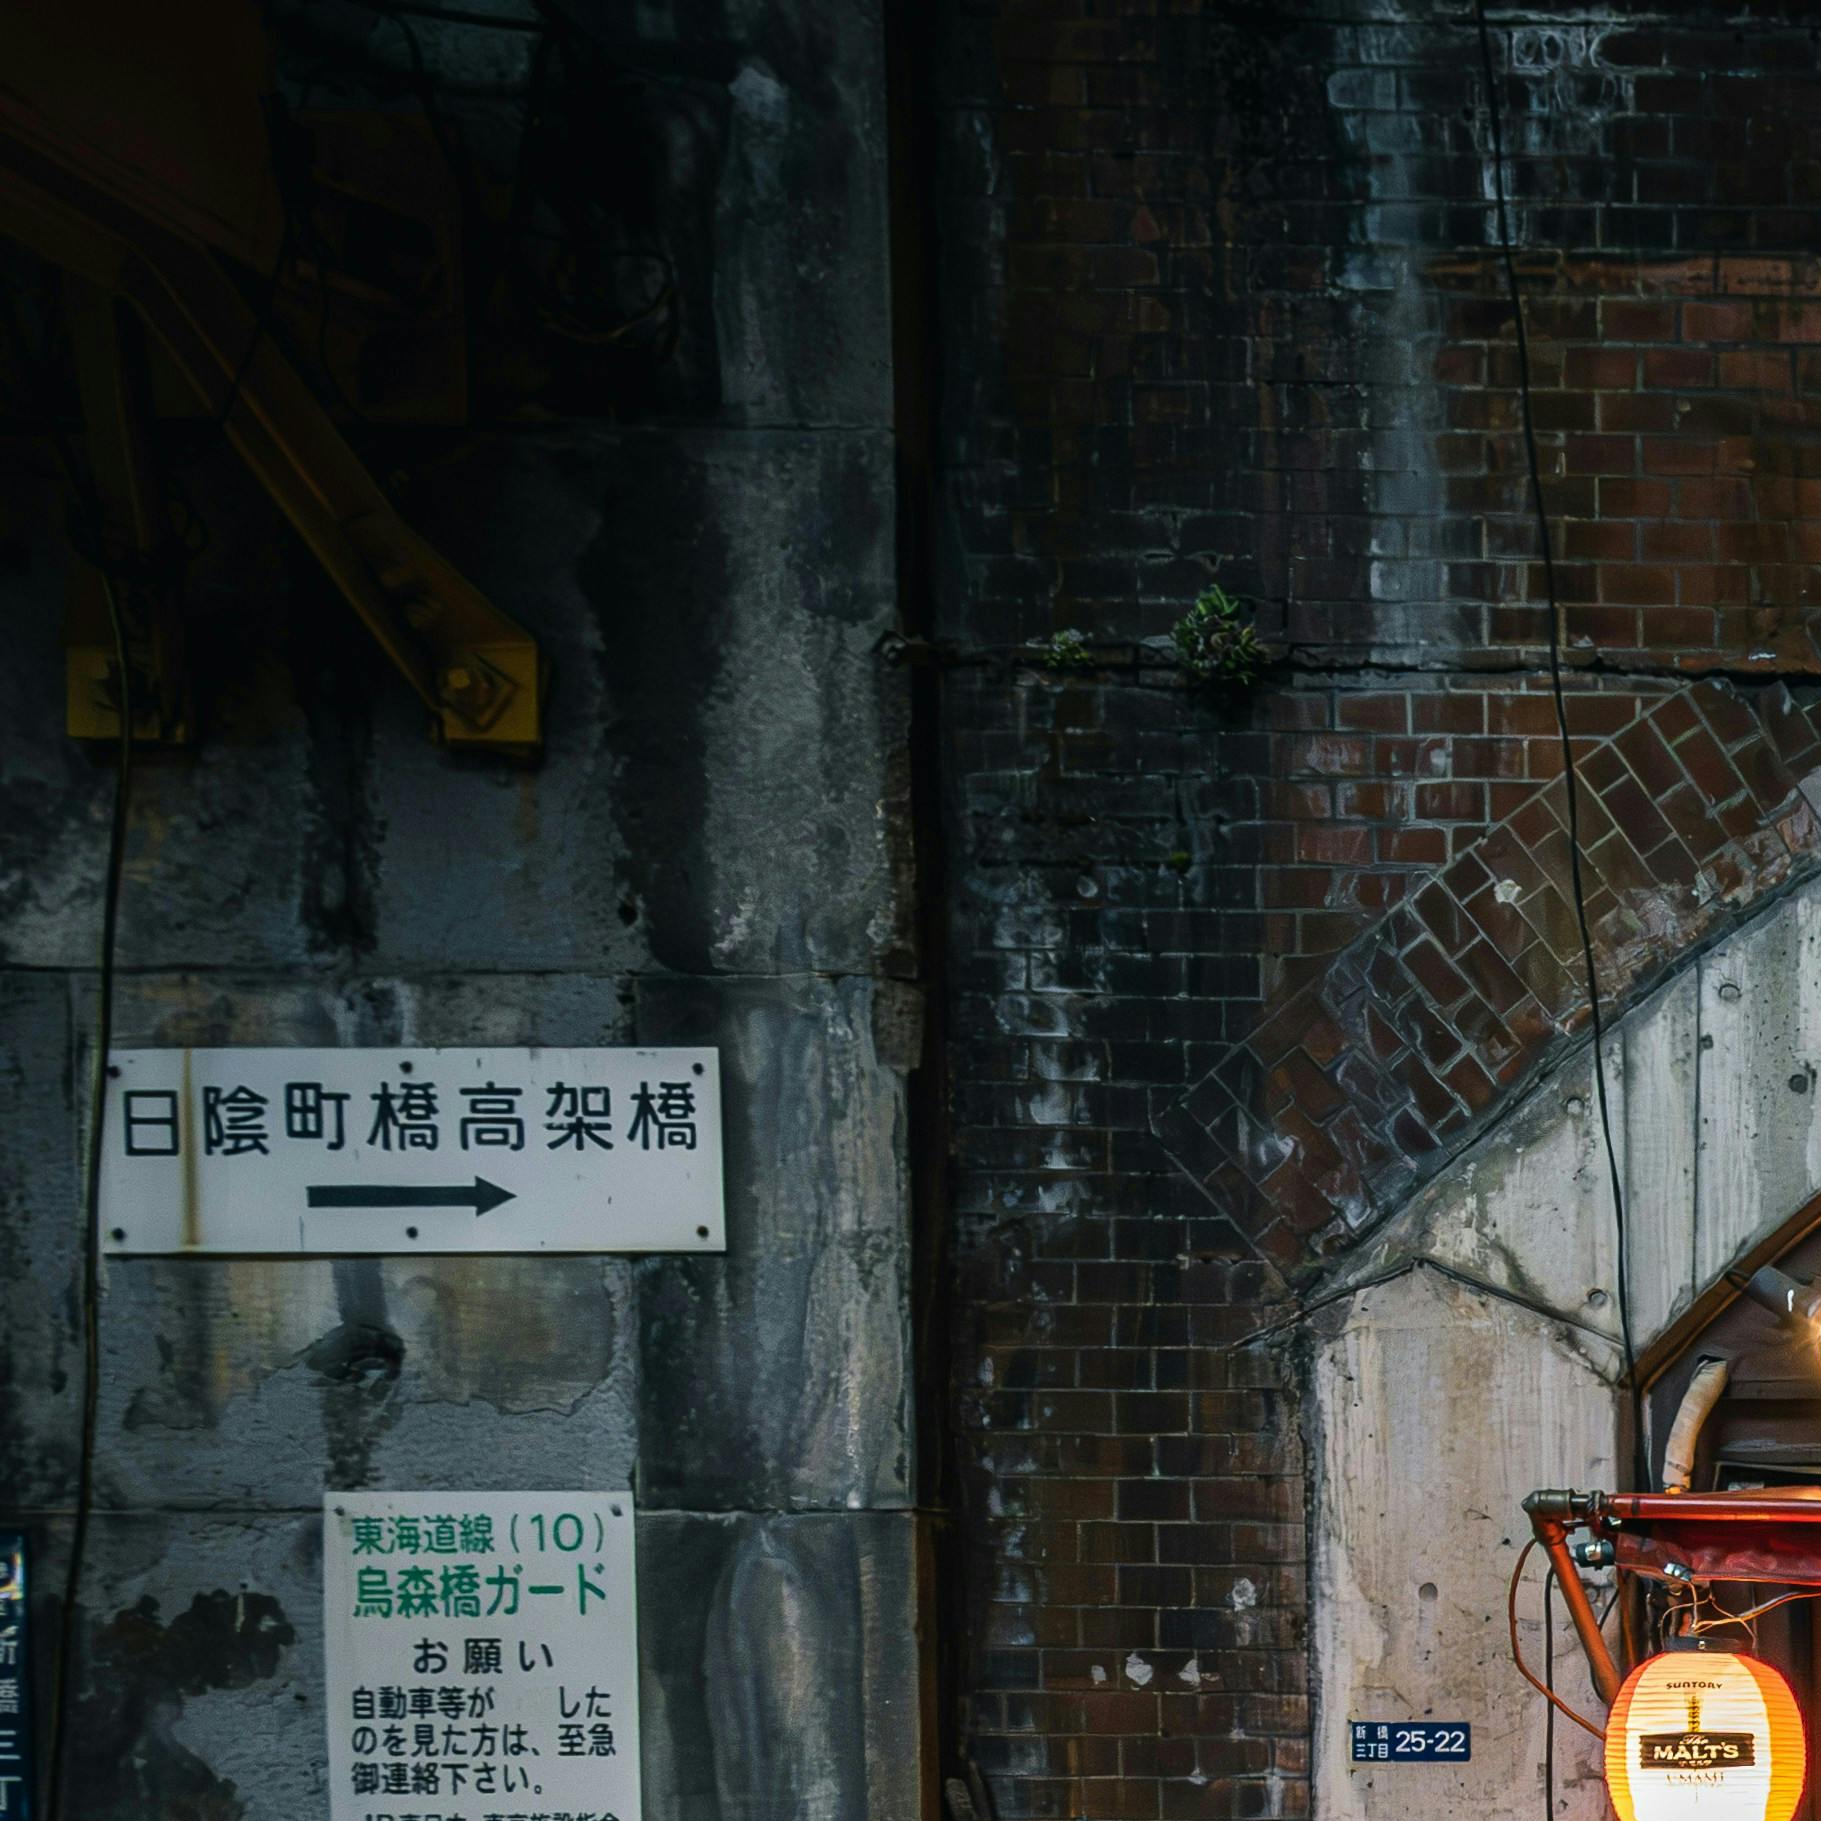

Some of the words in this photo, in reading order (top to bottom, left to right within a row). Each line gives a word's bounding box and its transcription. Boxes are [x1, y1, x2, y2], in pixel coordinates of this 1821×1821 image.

[123, 1080, 698, 1157] 日陰町橋高架橋
[413, 1637, 554, 1675] お願い
[1667, 1681, 1723, 1690] SUNTORY
[352, 1686, 495, 1720] 自動車等が
[558, 1686, 612, 1719] した
[352, 1723, 616, 1757] のを見た方は、至急
[1356, 1726, 1389, 1740] 新橋
[1395, 1730, 1465, 1752] 25-22
[1356, 1743, 1389, 1758] 三丁目
[1654, 1742, 1739, 1760] MALT'S
[352, 1763, 543, 1795] 御連絡下さい。
